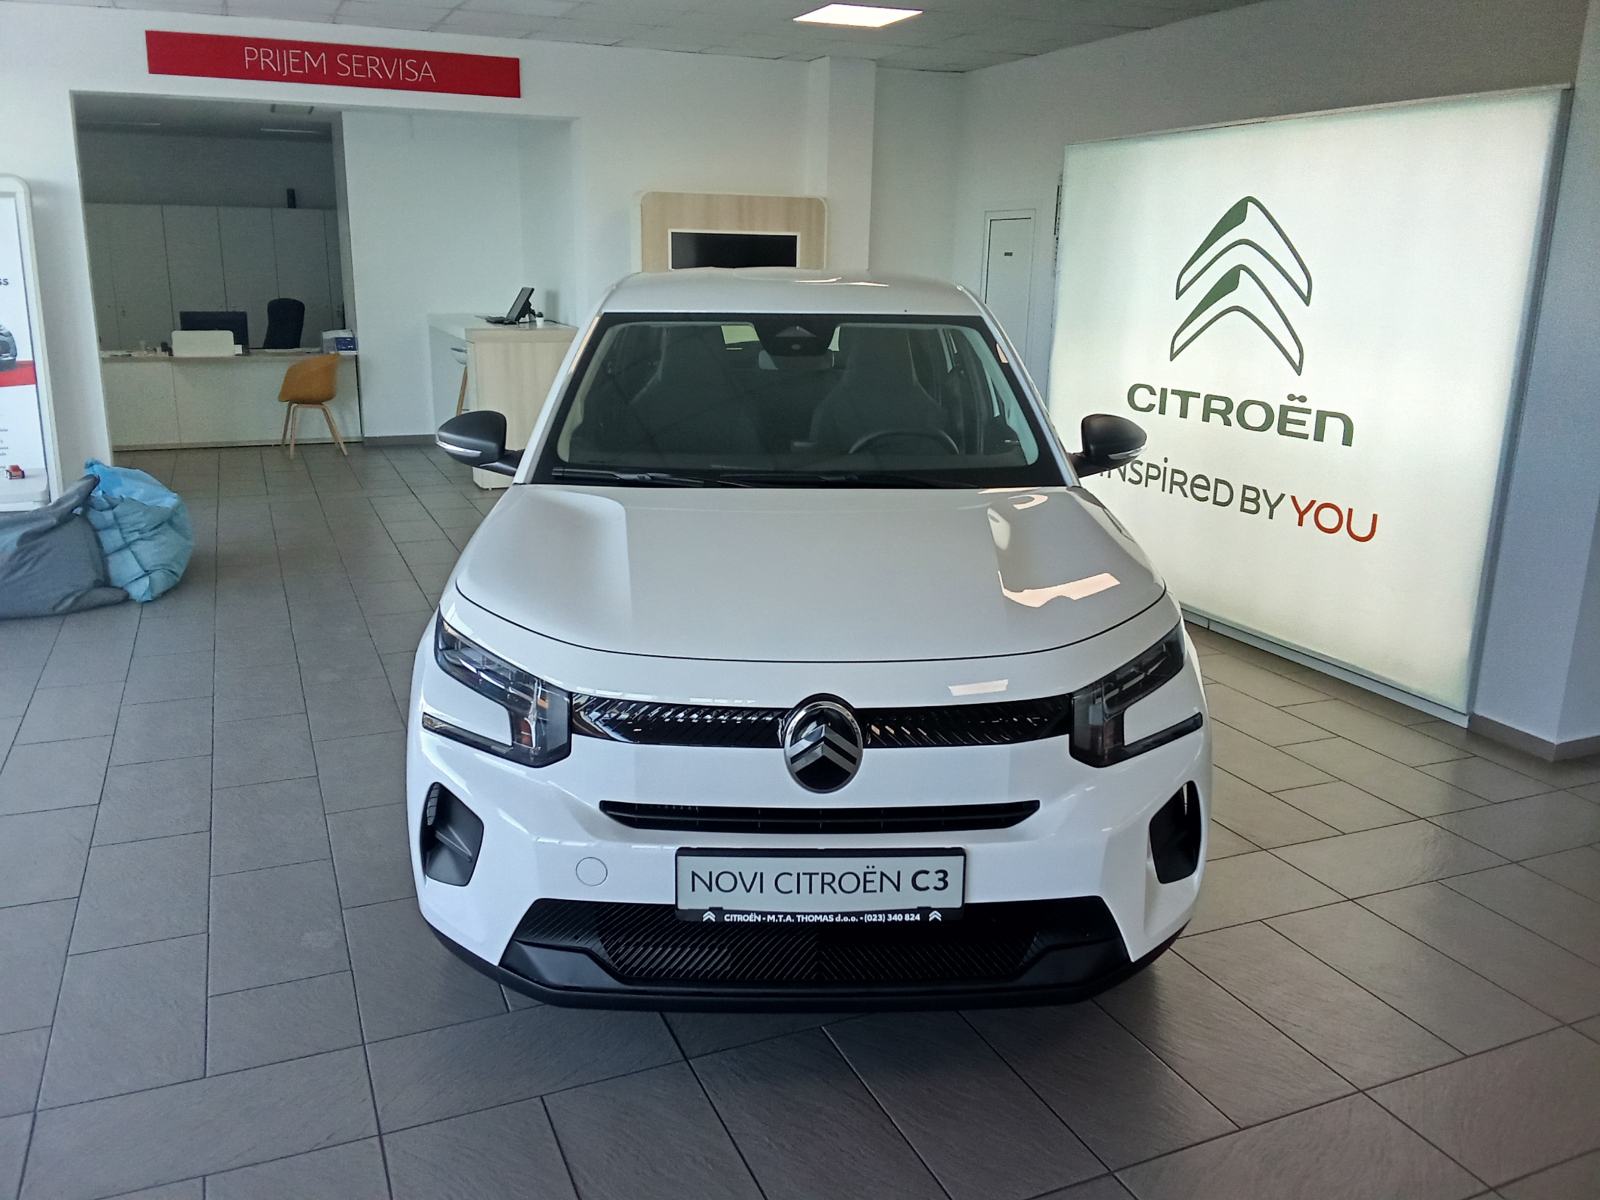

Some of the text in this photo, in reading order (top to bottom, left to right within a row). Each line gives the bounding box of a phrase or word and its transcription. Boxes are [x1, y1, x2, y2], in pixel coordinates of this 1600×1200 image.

[244, 46, 436, 83] PRIJEM SERVISA
[1239, 484, 1286, 520] BY
[1290, 495, 1378, 543] YOU
[691, 865, 950, 895] NOVI CITROËN C3
[724, 912, 761, 922] CITROËN
[767, 914, 795, 923] M.T.A.
[796, 914, 834, 923] THOMAS
[835, 914, 858, 922] d.o.o.
[864, 913, 886, 923] (023)
[887, 913, 903, 922] 340
[904, 913, 920, 922] 824
